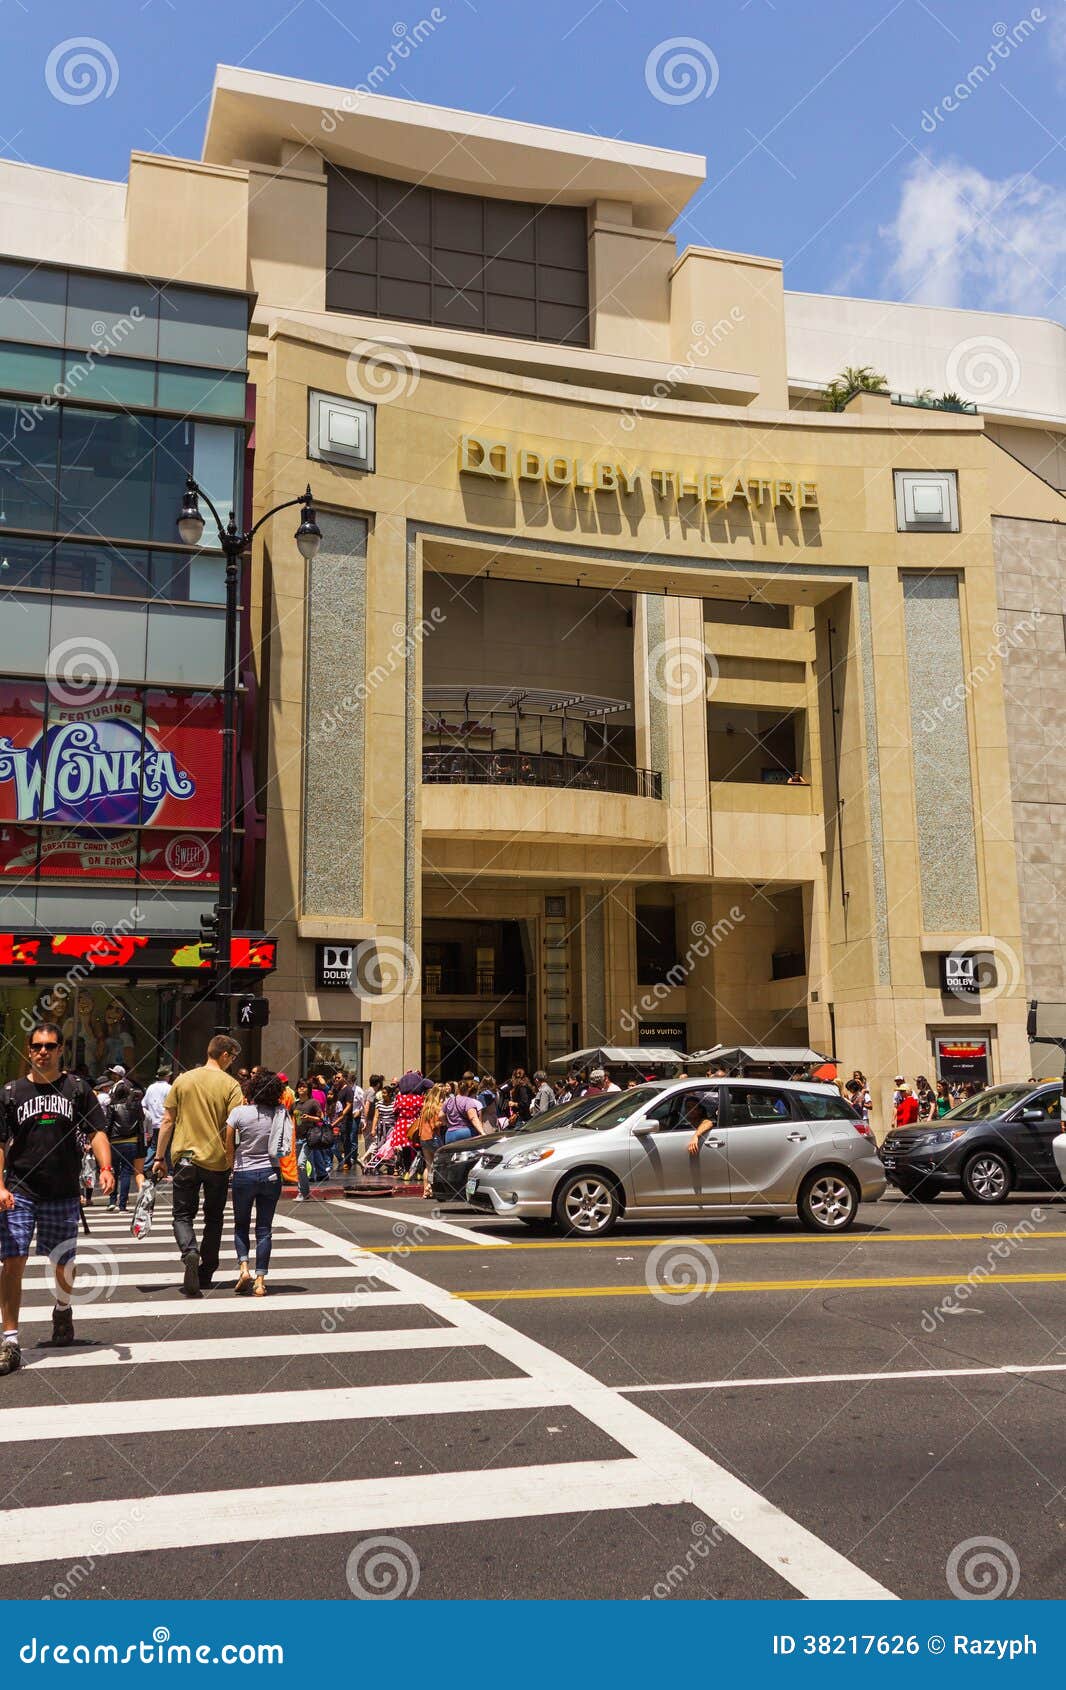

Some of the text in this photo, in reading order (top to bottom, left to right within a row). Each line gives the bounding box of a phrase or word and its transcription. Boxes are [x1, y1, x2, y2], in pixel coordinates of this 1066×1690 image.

[519, 447, 820, 510] DOLBY THEATRE
[59, 703, 132, 722] FEATURING
[0, 721, 192, 821] WONKA
[41, 841, 82, 853] GREATEST
[83, 842, 108, 851] CANDY
[88, 856, 134, 866] ON EARTH
[323, 970, 352, 979] DOLBY
[946, 978, 974, 986] DOLBY
[639, 1028, 656, 1036] OUIS
[17, 1094, 74, 1126] CALIFORNIA
